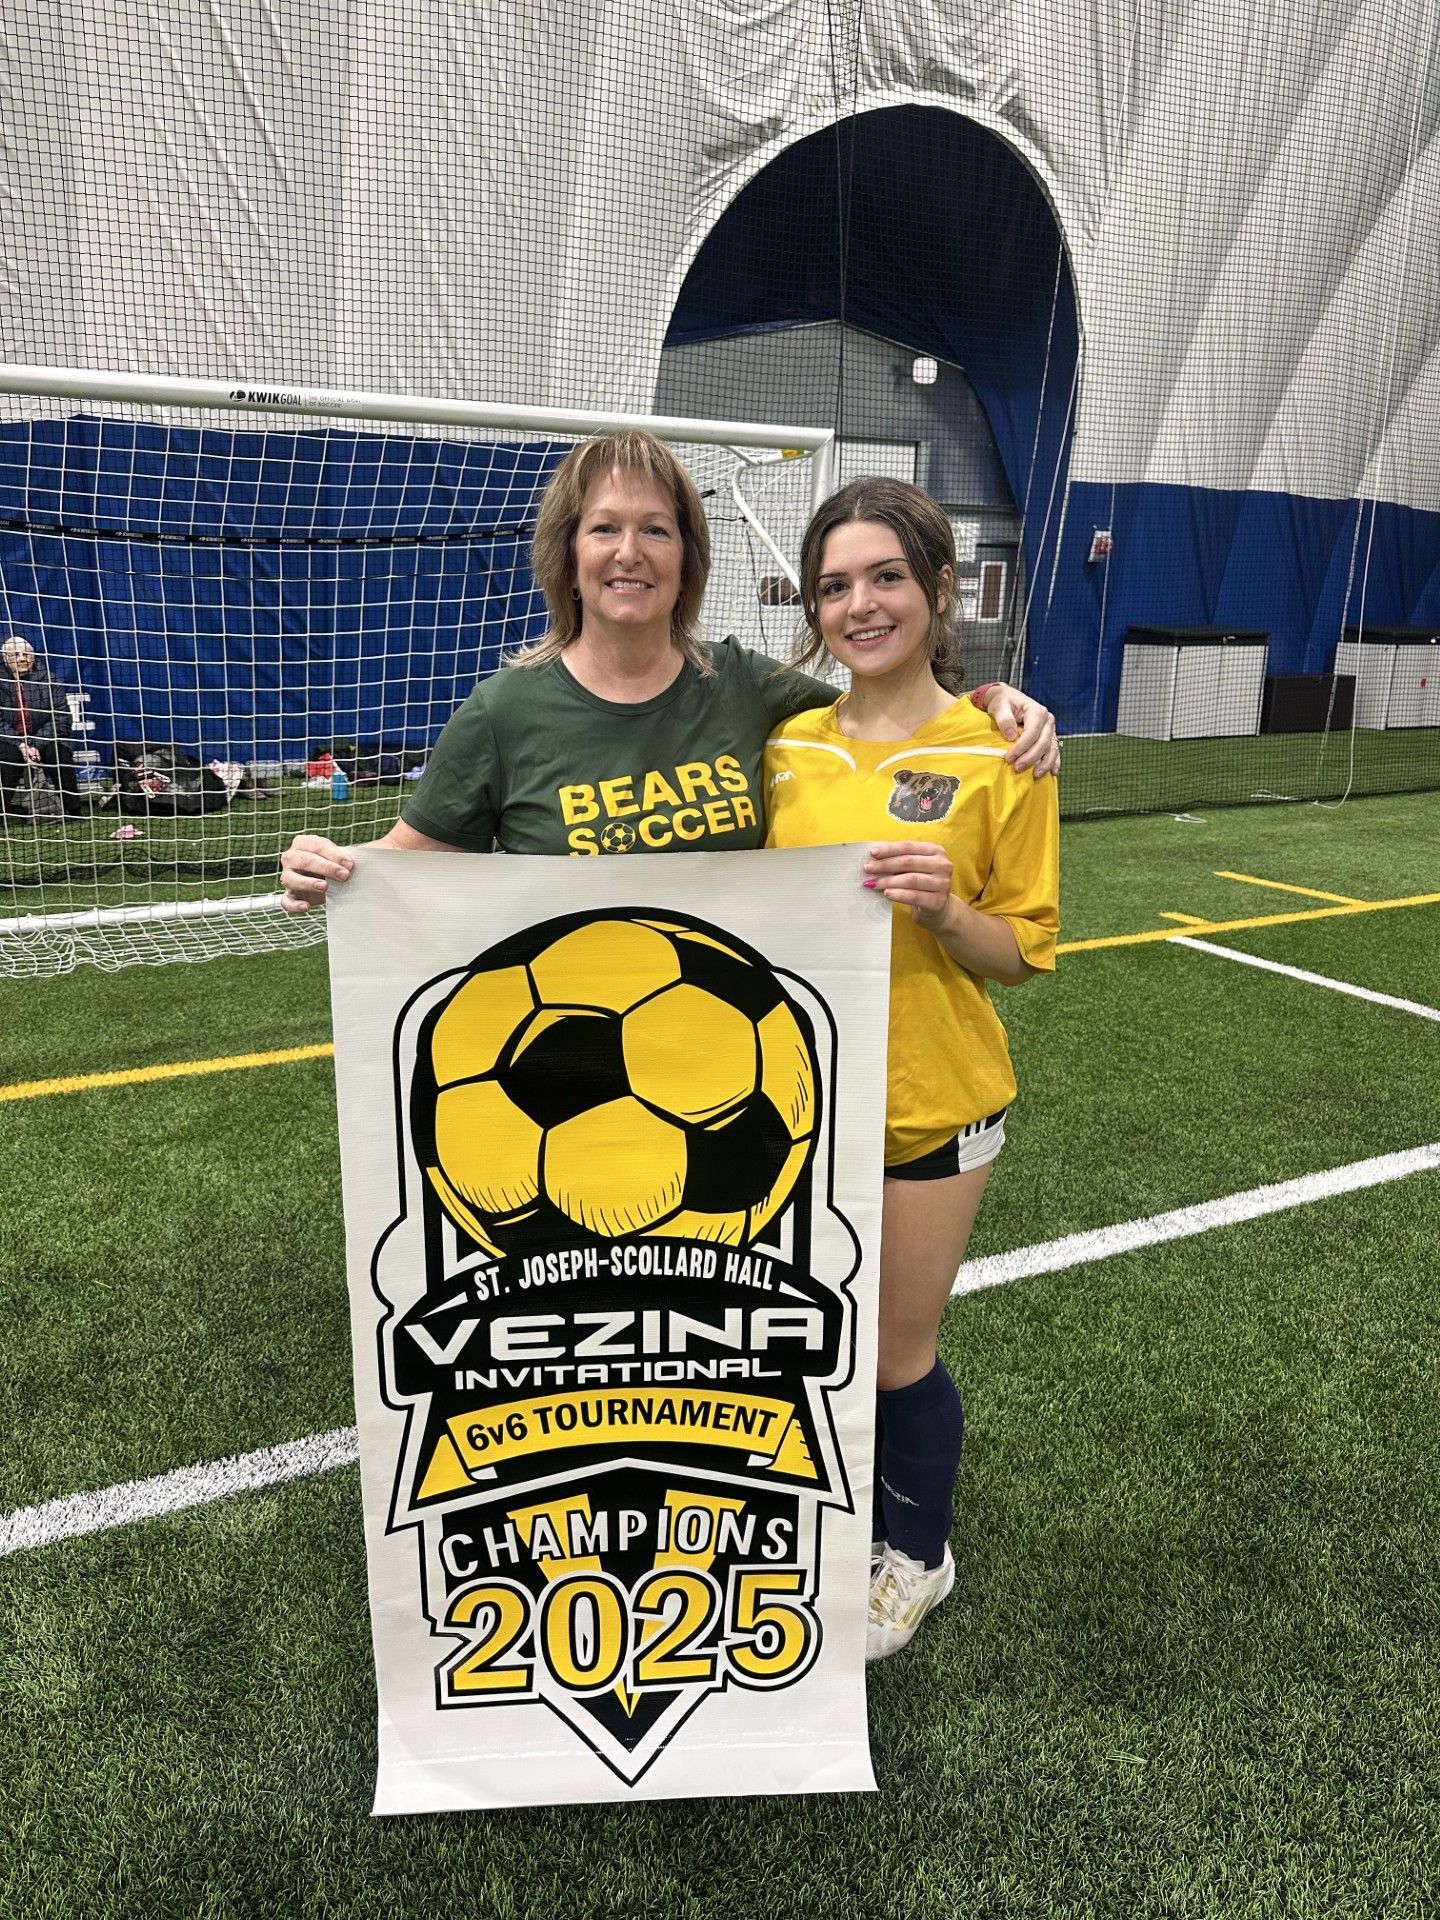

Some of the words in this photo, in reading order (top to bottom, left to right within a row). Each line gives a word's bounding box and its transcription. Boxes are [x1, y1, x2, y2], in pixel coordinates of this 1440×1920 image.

[248, 391, 302, 406] KWIKGOAL
[558, 754, 749, 826] BEARS
[473, 1266, 510, 1301] ST.
[518, 1245, 716, 1290] JOSEPH-SCOLLARD
[723, 1254, 774, 1291] HALL
[403, 1306, 824, 1366] VEZINA
[454, 1357, 782, 1391] INVITATIONAL
[465, 1411, 529, 1452] 6v6
[533, 1397, 779, 1439] TOURNAMENT
[442, 1506, 794, 1578] CHAMPIONS
[447, 1571, 810, 1693] 2025
